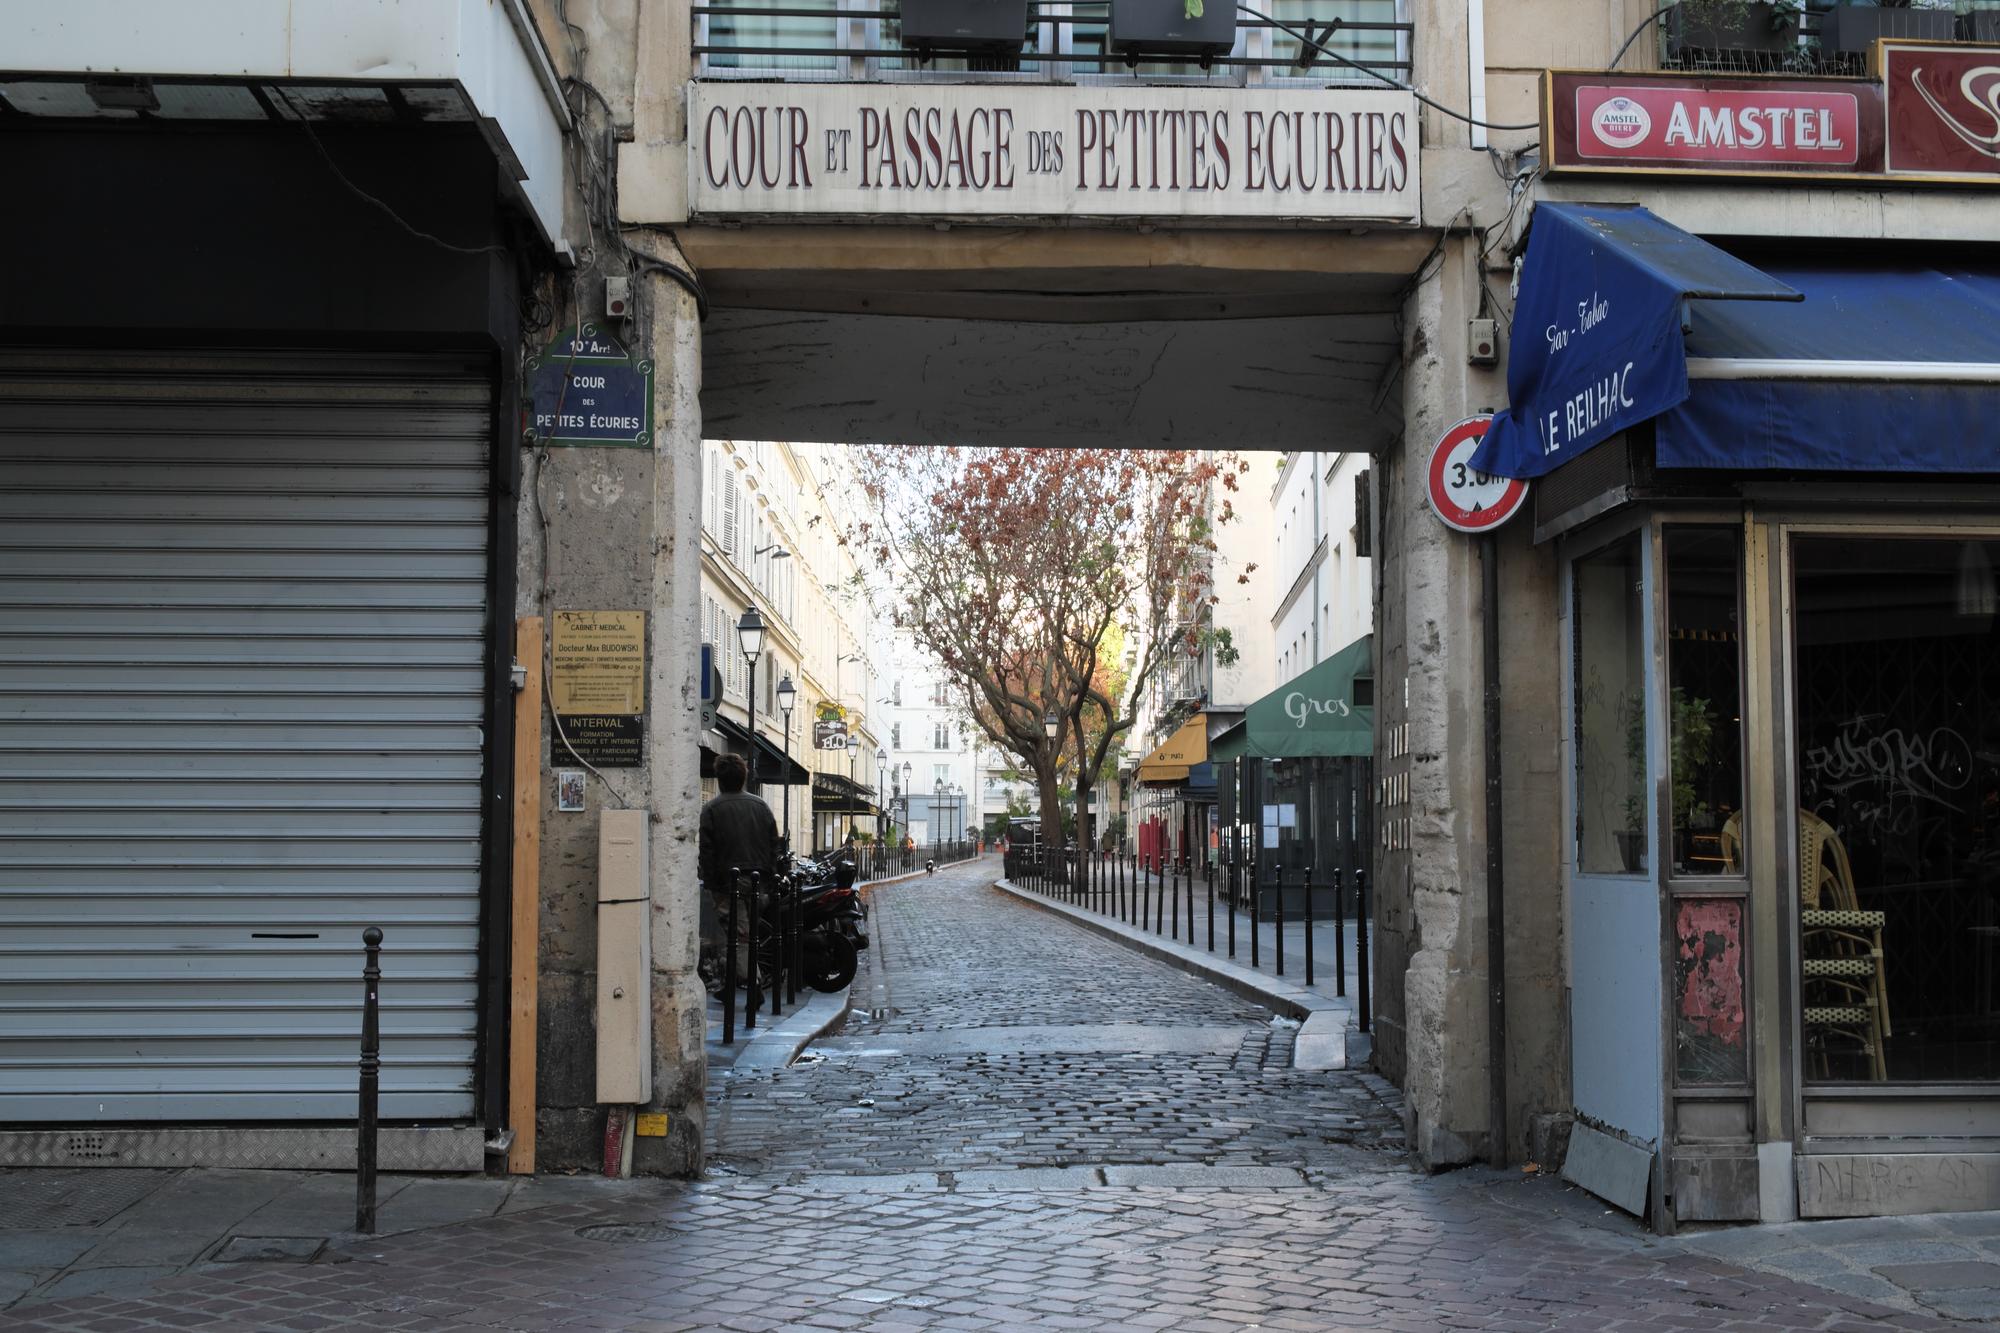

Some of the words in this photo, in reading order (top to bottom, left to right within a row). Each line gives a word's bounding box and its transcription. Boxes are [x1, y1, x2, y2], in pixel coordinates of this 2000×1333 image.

[1603, 114, 1639, 123] AMSTEL
[1665, 101, 1844, 150] AMSTEL
[705, 106, 812, 190] COUR
[824, 128, 851, 174] ET
[859, 107, 1015, 192] PASSAGE
[1026, 130, 1063, 176] DES
[1077, 109, 1231, 192] PETITES
[1244, 111, 1408, 194] ECURIES
[1578, 291, 1609, 335] Tabac
[573, 376, 605, 388] COUR
[590, 413, 639, 429] ÉCURIES
[1540, 410, 1560, 456] LE
[1566, 361, 1634, 442] REILHAC
[558, 644, 585, 652] Docteur
[586, 644, 600, 652] Max
[601, 644, 639, 652] BUDOWSKI
[570, 718, 624, 728] INTERVAL
[1284, 692, 1350, 729] Gros
